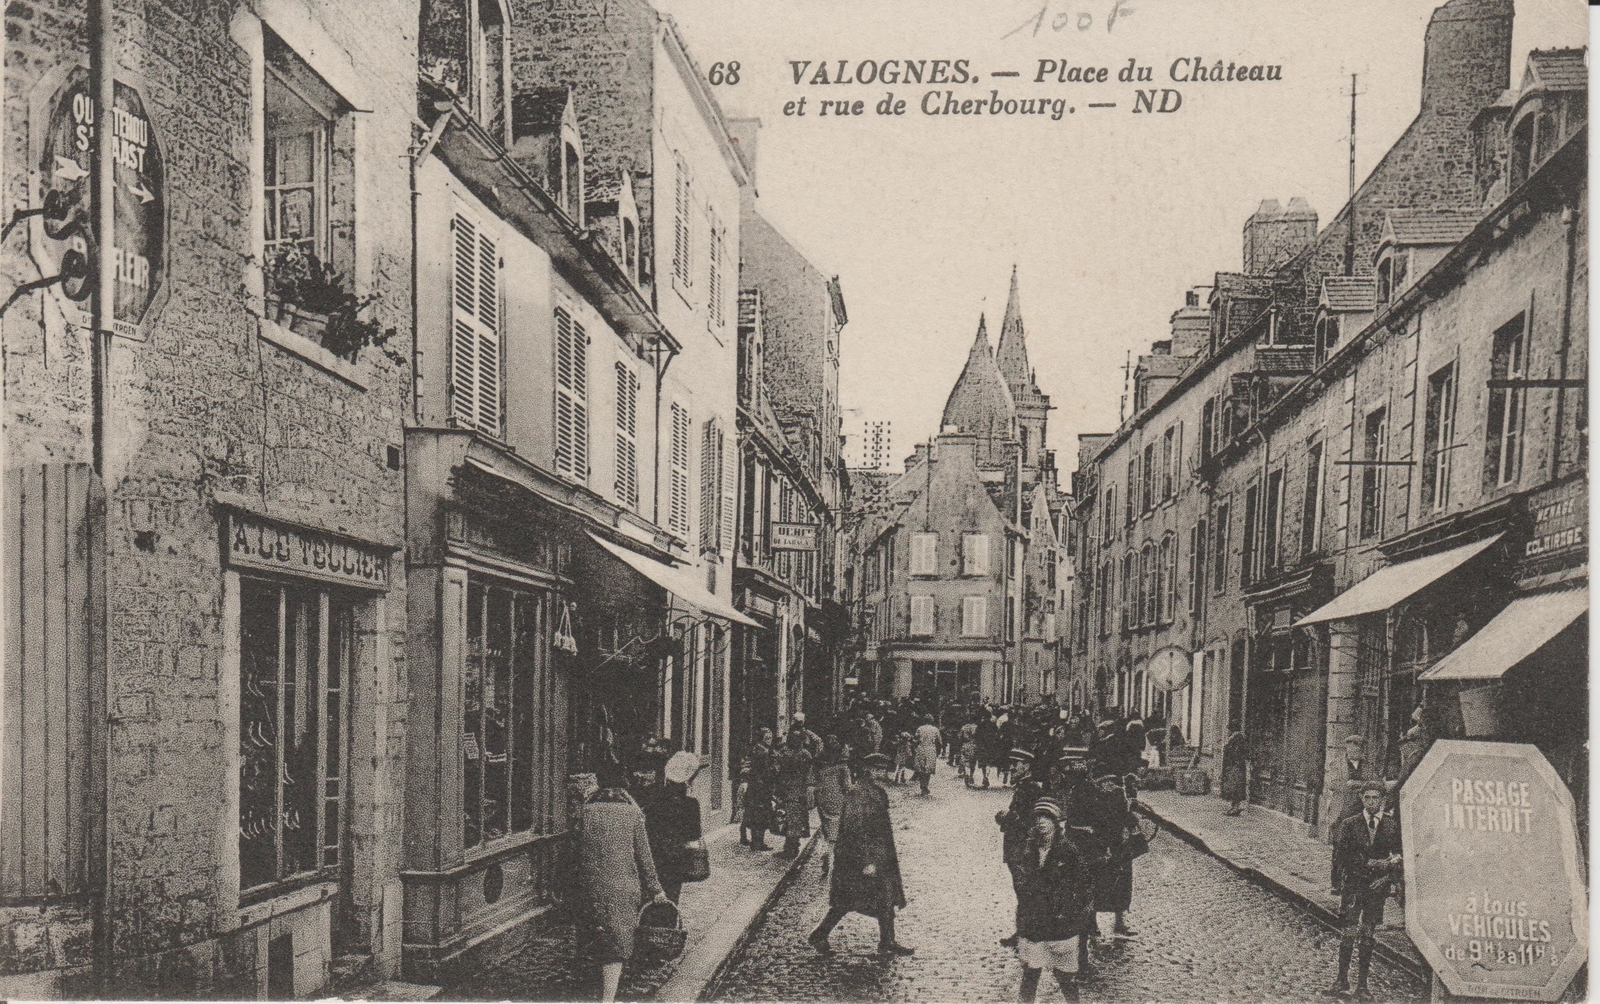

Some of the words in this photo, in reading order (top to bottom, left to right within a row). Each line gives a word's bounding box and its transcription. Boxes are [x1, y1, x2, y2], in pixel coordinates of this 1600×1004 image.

[1000, 5, 1093, 39] 100
[299, 535, 387, 581] TELLIER
[1452, 777, 1531, 808] PASSAGE
[1444, 803, 1533, 834] INTERDIT
[1483, 892, 1528, 917] tous
[1448, 914, 1552, 942] VEHICULES
[1445, 943, 1465, 961] de
